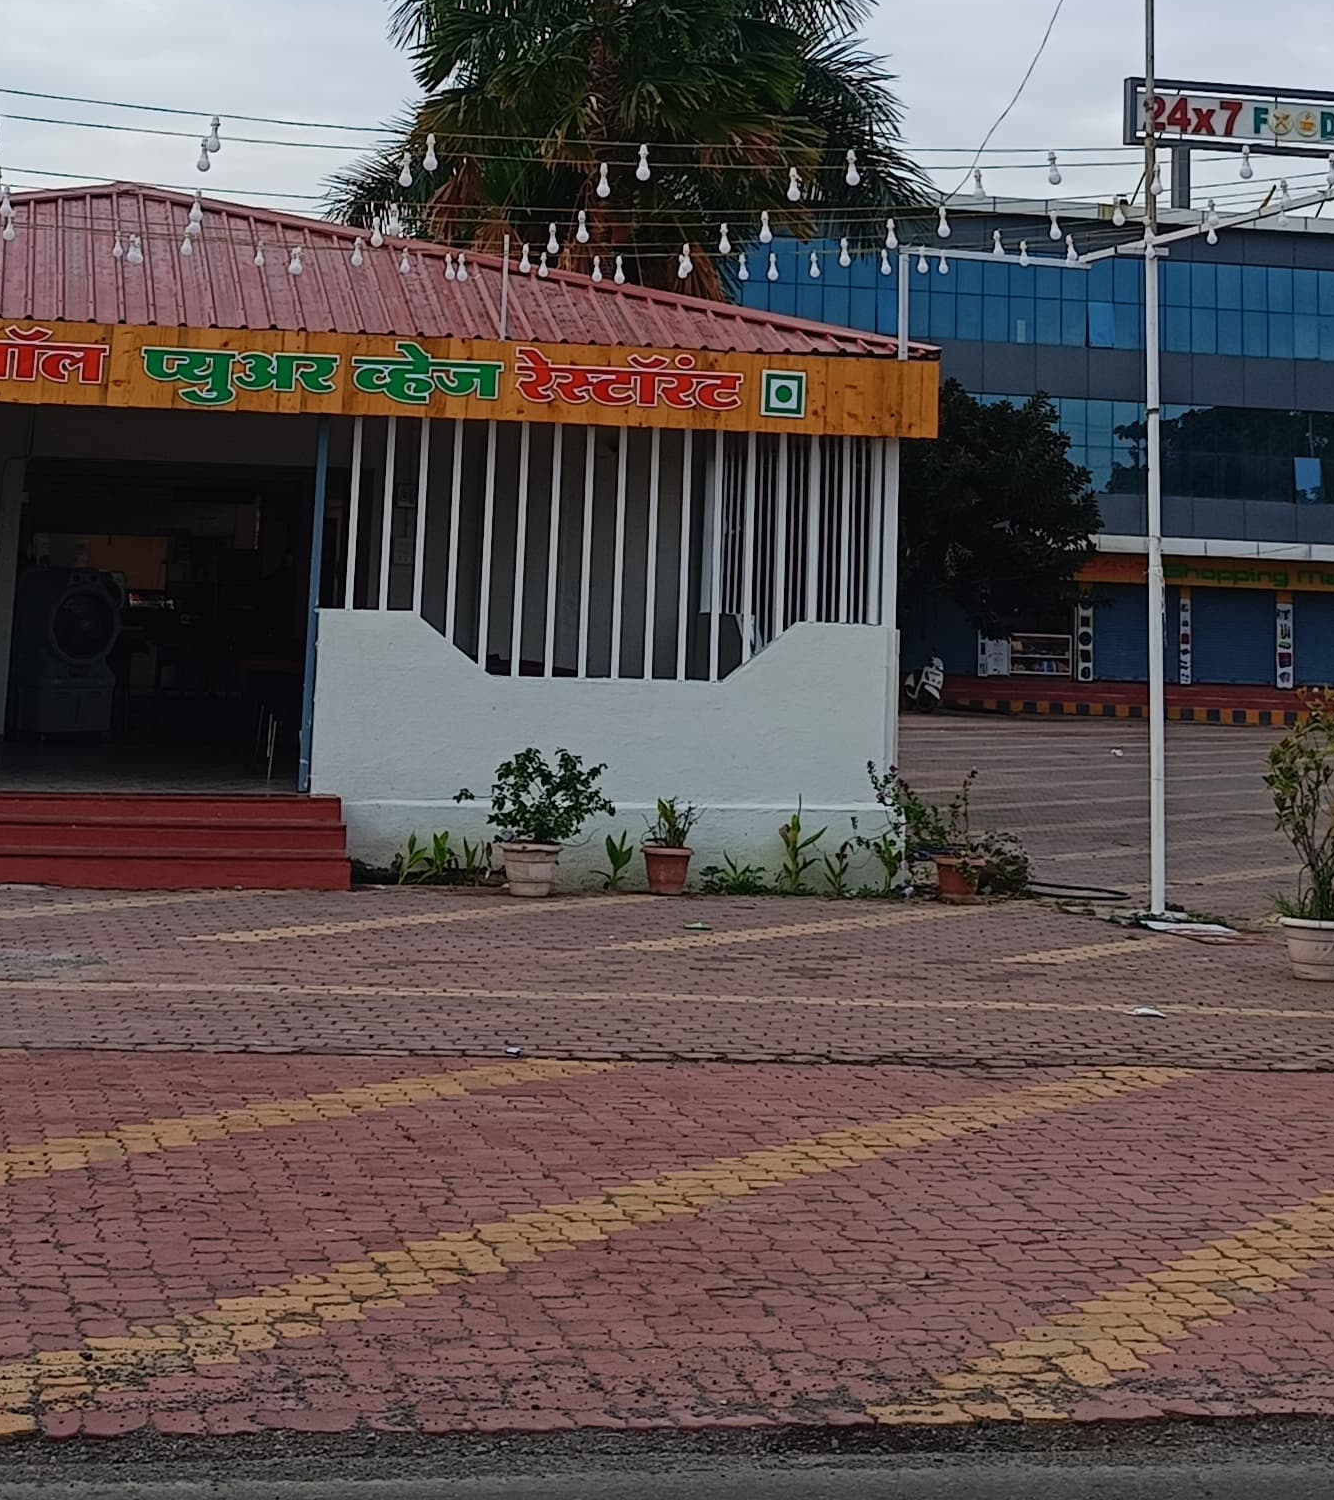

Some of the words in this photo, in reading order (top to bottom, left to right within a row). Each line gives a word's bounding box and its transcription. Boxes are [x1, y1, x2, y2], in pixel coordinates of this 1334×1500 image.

[142, 346, 340, 405] प्युअर
[351, 341, 504, 404] व्हेज
[515, 346, 744, 411] रेस्टॉरंट
